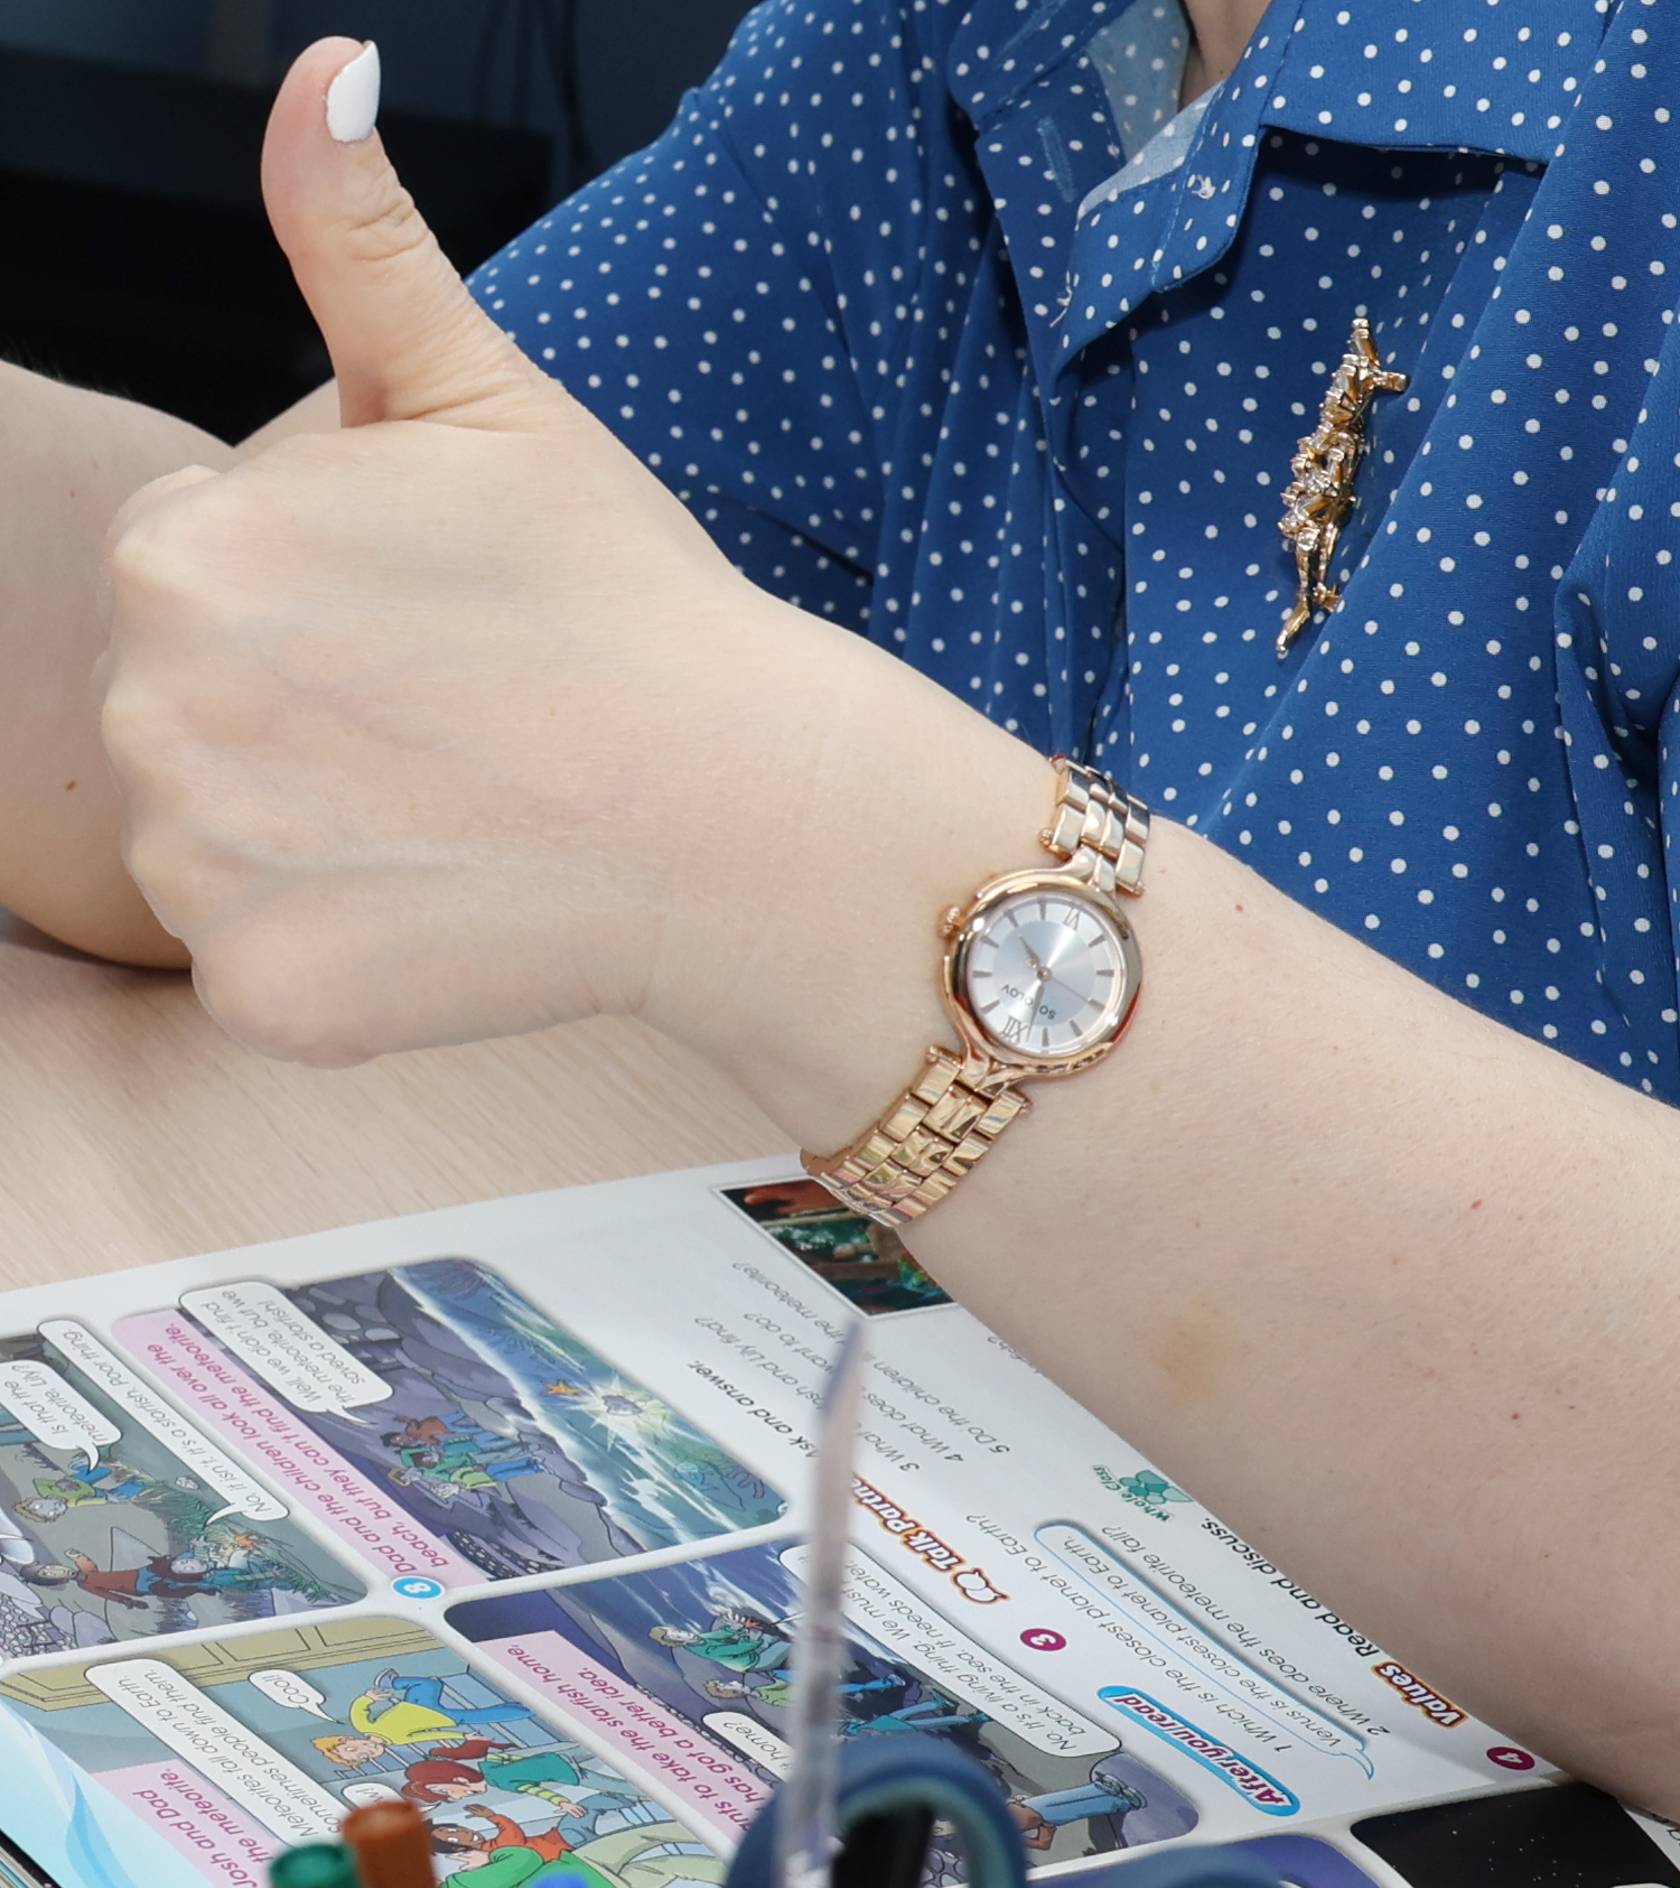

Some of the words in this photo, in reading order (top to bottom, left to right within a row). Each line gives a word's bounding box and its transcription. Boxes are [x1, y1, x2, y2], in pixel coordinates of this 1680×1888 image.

[1001, 984, 1056, 1020] SOOLOV
[688, 1360, 755, 1407] answer.
[746, 1408, 793, 1434] and
[852, 1472, 916, 1533] Partn
[906, 1530, 960, 1570] Talk
[965, 1514, 1028, 1556] Earth?
[1201, 1521, 1277, 1575] discuss.
[1024, 1556, 1048, 1573] to
[402, 1580, 430, 1596] 8
[1039, 1574, 1111, 1620] planet
[1270, 1577, 1322, 1610] and
[1028, 1631, 1053, 1650] 3
[1098, 1621, 1167, 1668] closest
[1314, 1612, 1380, 1658] Read
[261, 1675, 310, 1705] Cool!
[1164, 1669, 1201, 1692] the
[1196, 1691, 1219, 1703] is
[1377, 1664, 1461, 1727] Values
[1114, 1695, 1174, 1730] read
[1215, 1703, 1277, 1743] Which
[1173, 1729, 1226, 1760] you
[1273, 1744, 1293, 1753] 1
[1502, 1751, 1522, 1766] 4
[1223, 1759, 1286, 1806] After
